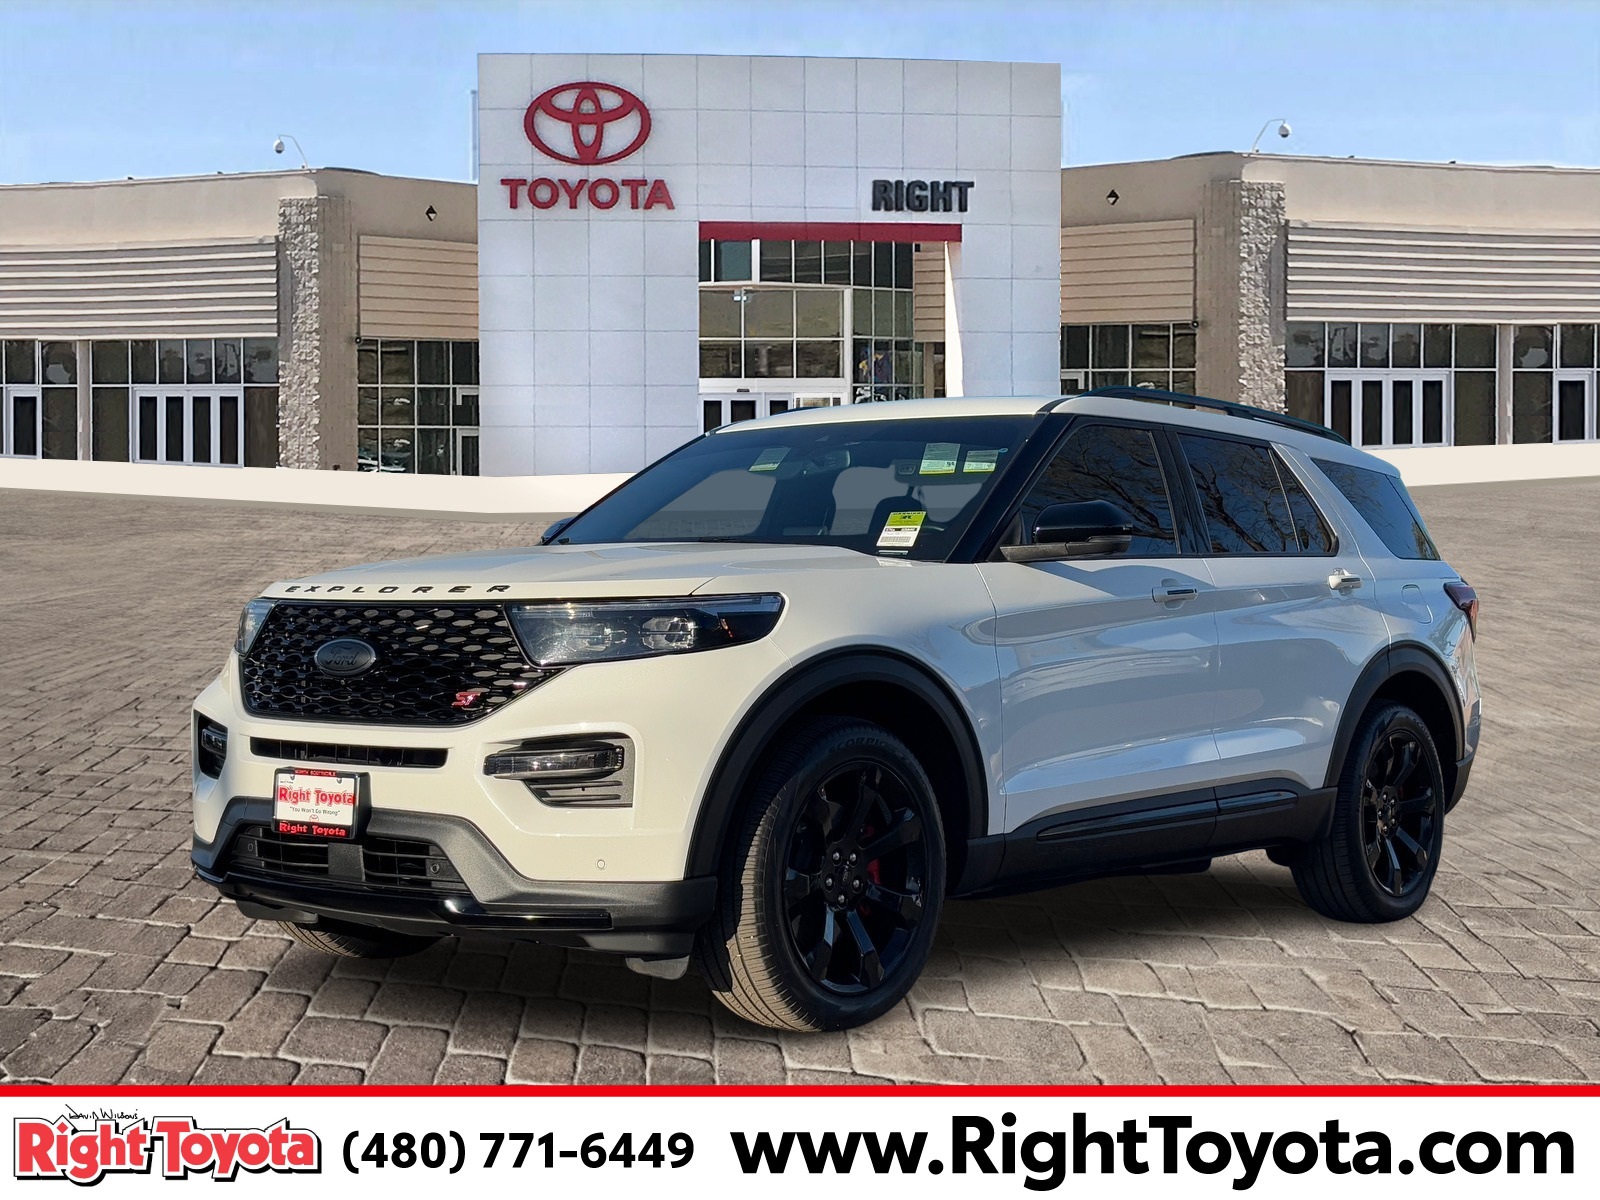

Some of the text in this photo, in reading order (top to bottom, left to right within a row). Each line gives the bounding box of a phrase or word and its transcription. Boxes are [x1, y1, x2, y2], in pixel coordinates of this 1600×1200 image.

[500, 178, 674, 210] TOYOTA
[871, 179, 975, 213] RIGHT
[285, 585, 511, 593] EXPLORER
[325, 646, 360, 666] Ford
[452, 691, 482, 706] ST
[279, 786, 356, 806] Right Toyota
[279, 822, 346, 837] Right Toyota
